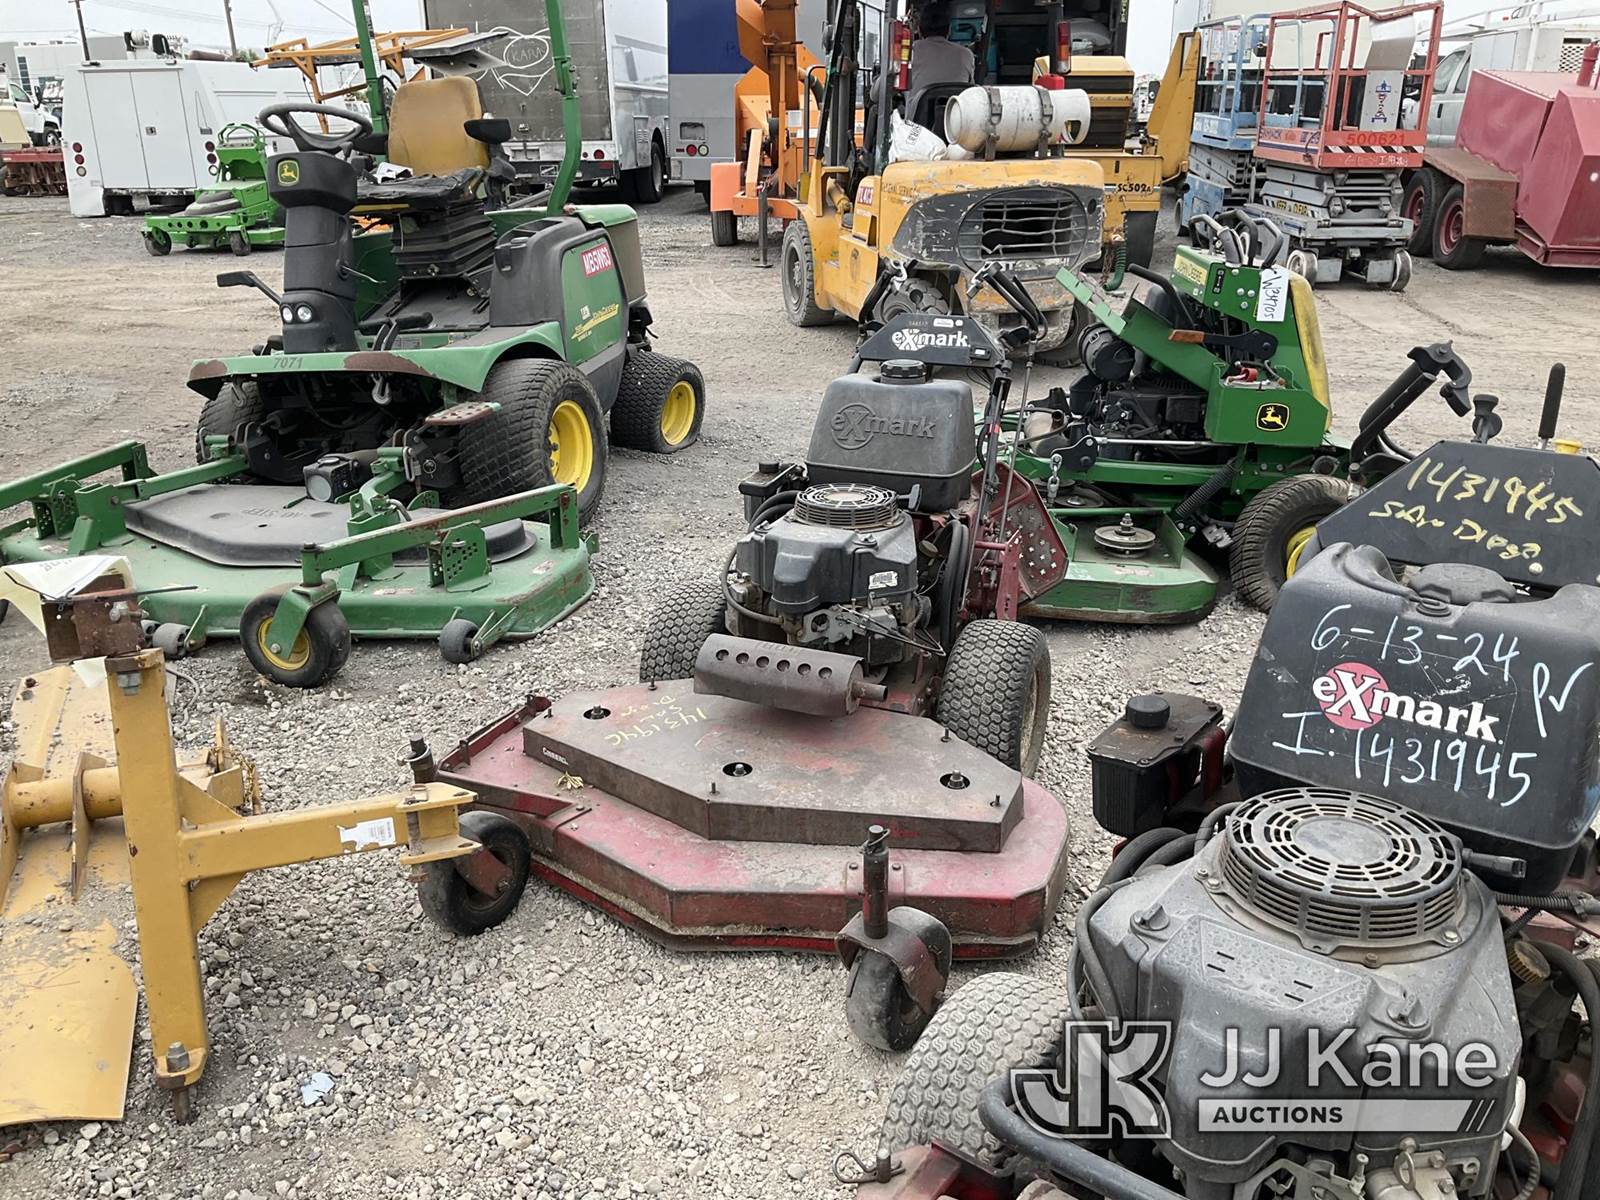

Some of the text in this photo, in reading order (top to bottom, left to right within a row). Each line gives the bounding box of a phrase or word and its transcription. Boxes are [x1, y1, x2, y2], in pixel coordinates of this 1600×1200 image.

[1346, 133, 1406, 146] 500621
[273, 357, 304, 369] 7071
[1406, 457, 1584, 524] 1431945
[1311, 603, 1520, 682] 6-13-24
[1354, 727, 1539, 807] 1431945
